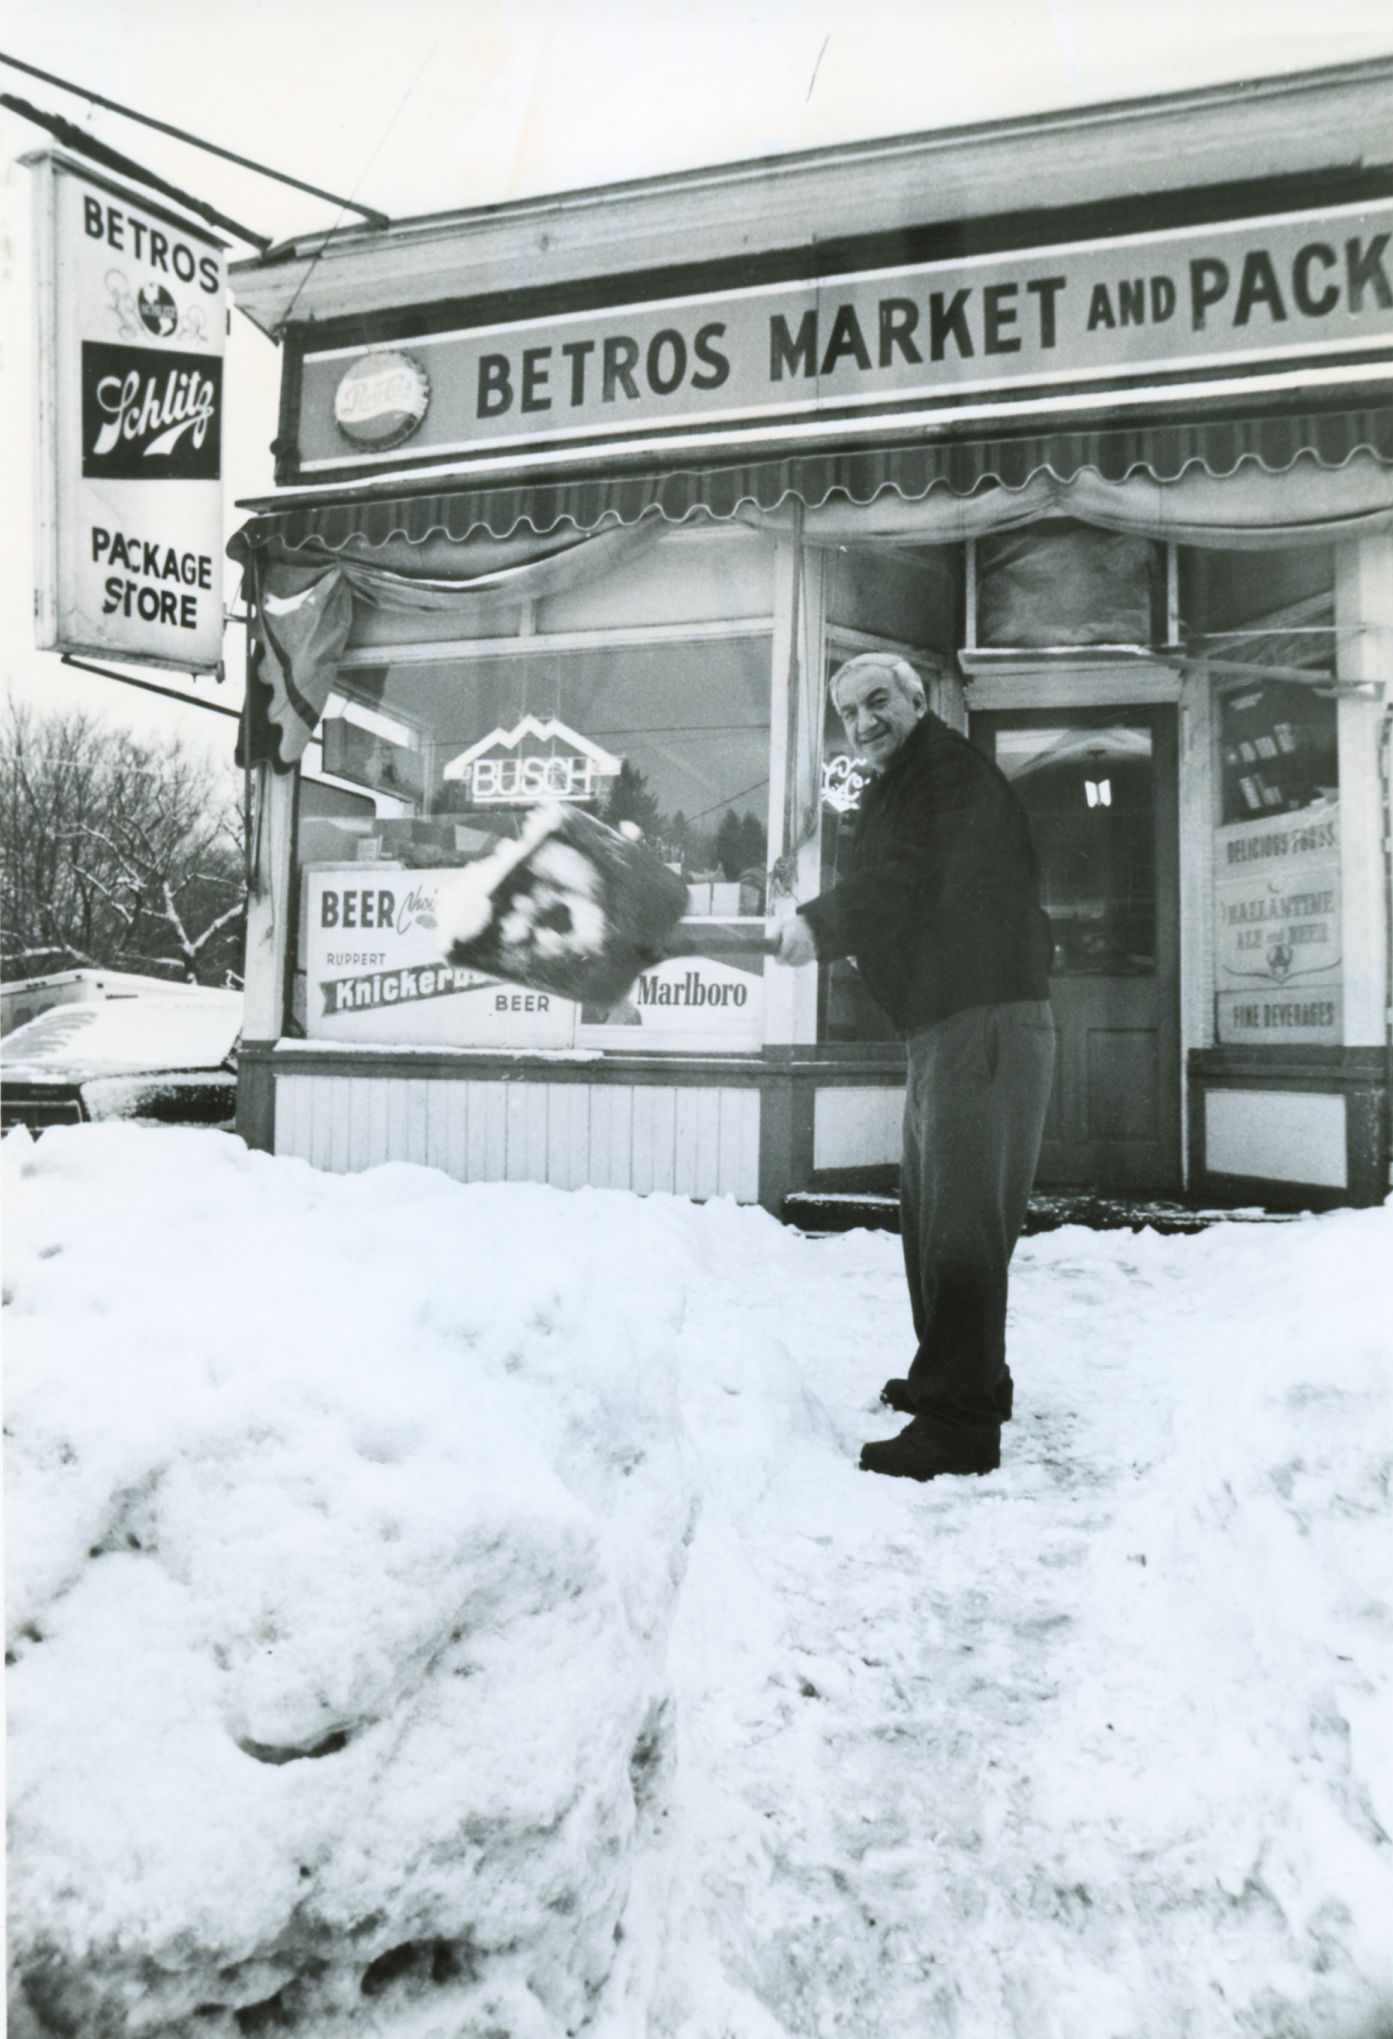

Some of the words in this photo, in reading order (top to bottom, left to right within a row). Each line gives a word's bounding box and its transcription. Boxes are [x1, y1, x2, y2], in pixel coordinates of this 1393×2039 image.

[83, 195, 220, 295] BETROS
[476, 322, 730, 419] BETROS
[769, 276, 1067, 382] MARKET
[1087, 275, 1175, 332] AND
[1188, 233, 1393, 332] PACK
[93, 369, 215, 454] Schlitz
[91, 525, 212, 590] PACKAGE
[102, 576, 198, 630] STORE
[472, 756, 593, 796] BUSCH
[1227, 832, 1288, 864] DELICIOUS
[321, 889, 396, 928] BEER
[327, 952, 387, 967] RUPPERT
[494, 994, 550, 1012] BEER
[637, 971, 748, 1007] Marlboro
[1232, 1002, 1260, 1029] FINE
[1263, 1000, 1335, 1028] BEVERAGES
